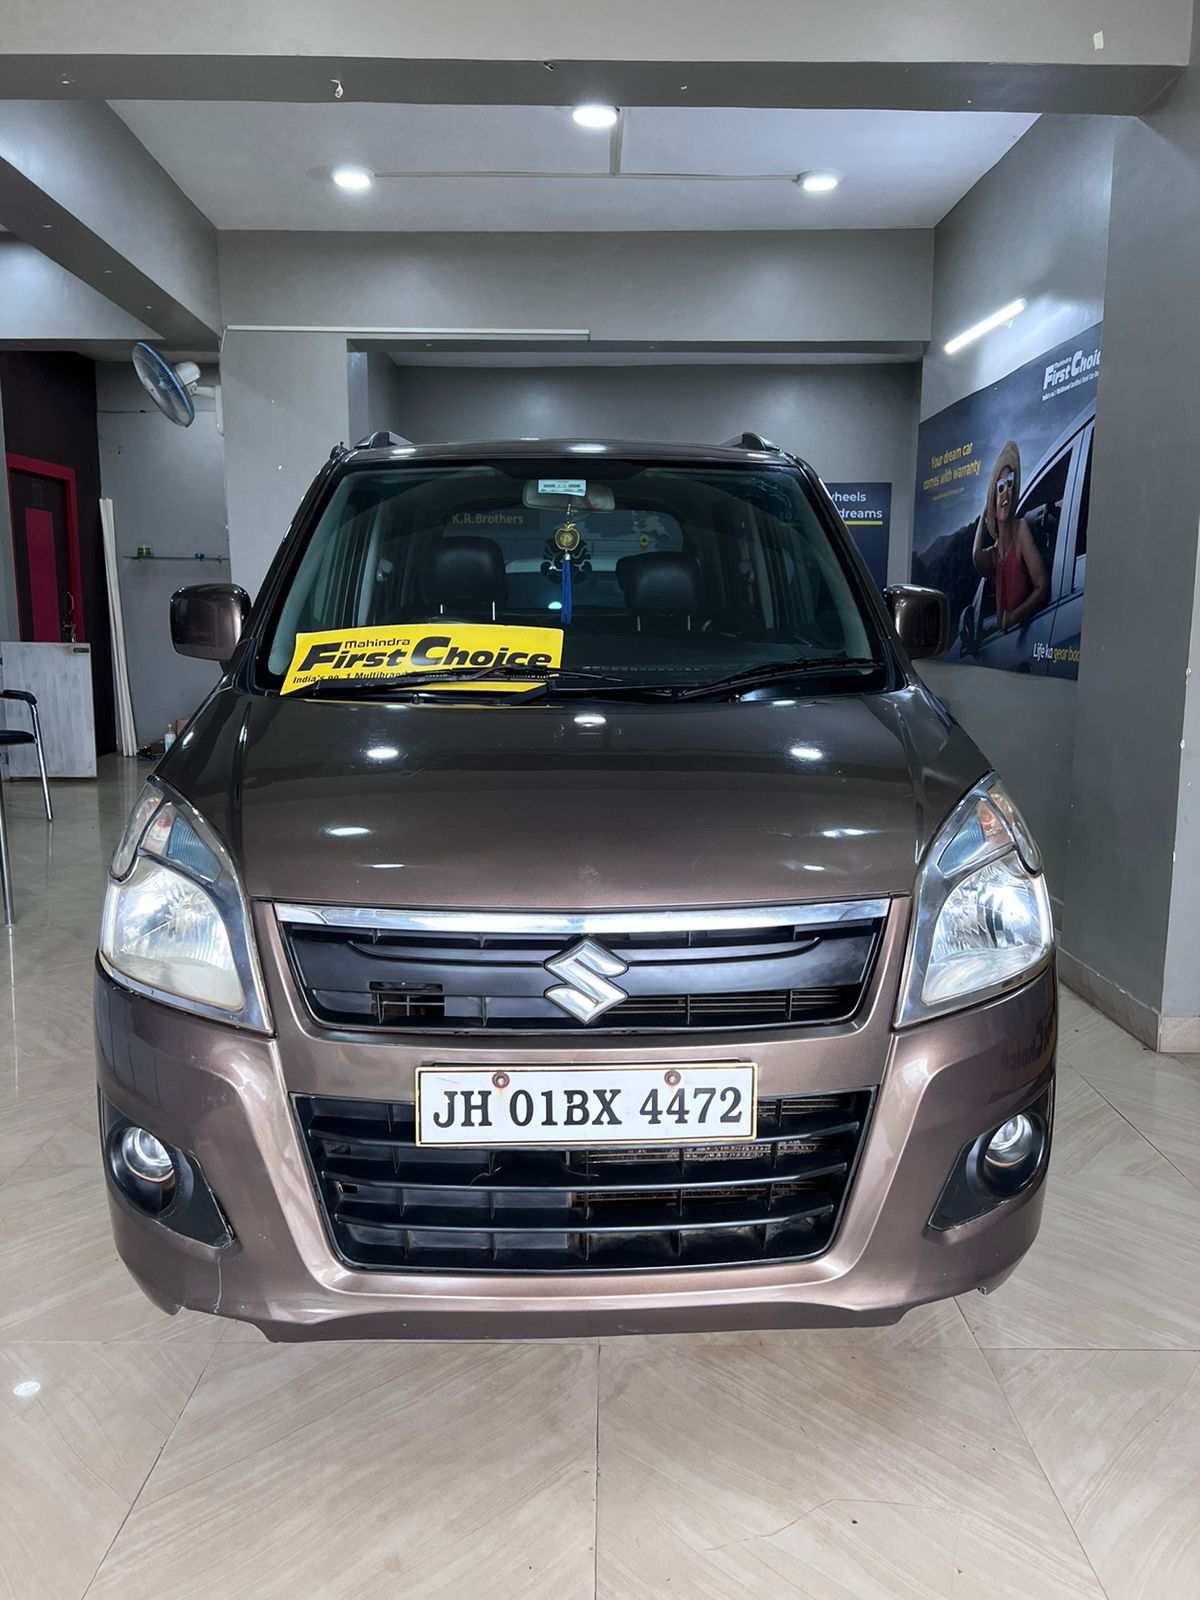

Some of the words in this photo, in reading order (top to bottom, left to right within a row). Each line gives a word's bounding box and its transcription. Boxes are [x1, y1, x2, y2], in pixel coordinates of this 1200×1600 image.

[1043, 363, 1071, 390] First
[1071, 349, 1101, 377] Choic
[943, 447, 962, 464] dream
[962, 442, 974, 456] car
[923, 475, 940, 490] comes
[952, 459, 982, 477] warranty
[839, 508, 883, 519] dreams
[297, 641, 408, 672] First
[410, 636, 552, 668] Choice
[344, 637, 411, 649] Mahindra
[1033, 642, 1045, 662] Life
[293, 675, 325, 684] India's
[433, 1090, 493, 1129] JH
[509, 1088, 623, 1127] 01BX
[639, 1086, 743, 1125] 4472
